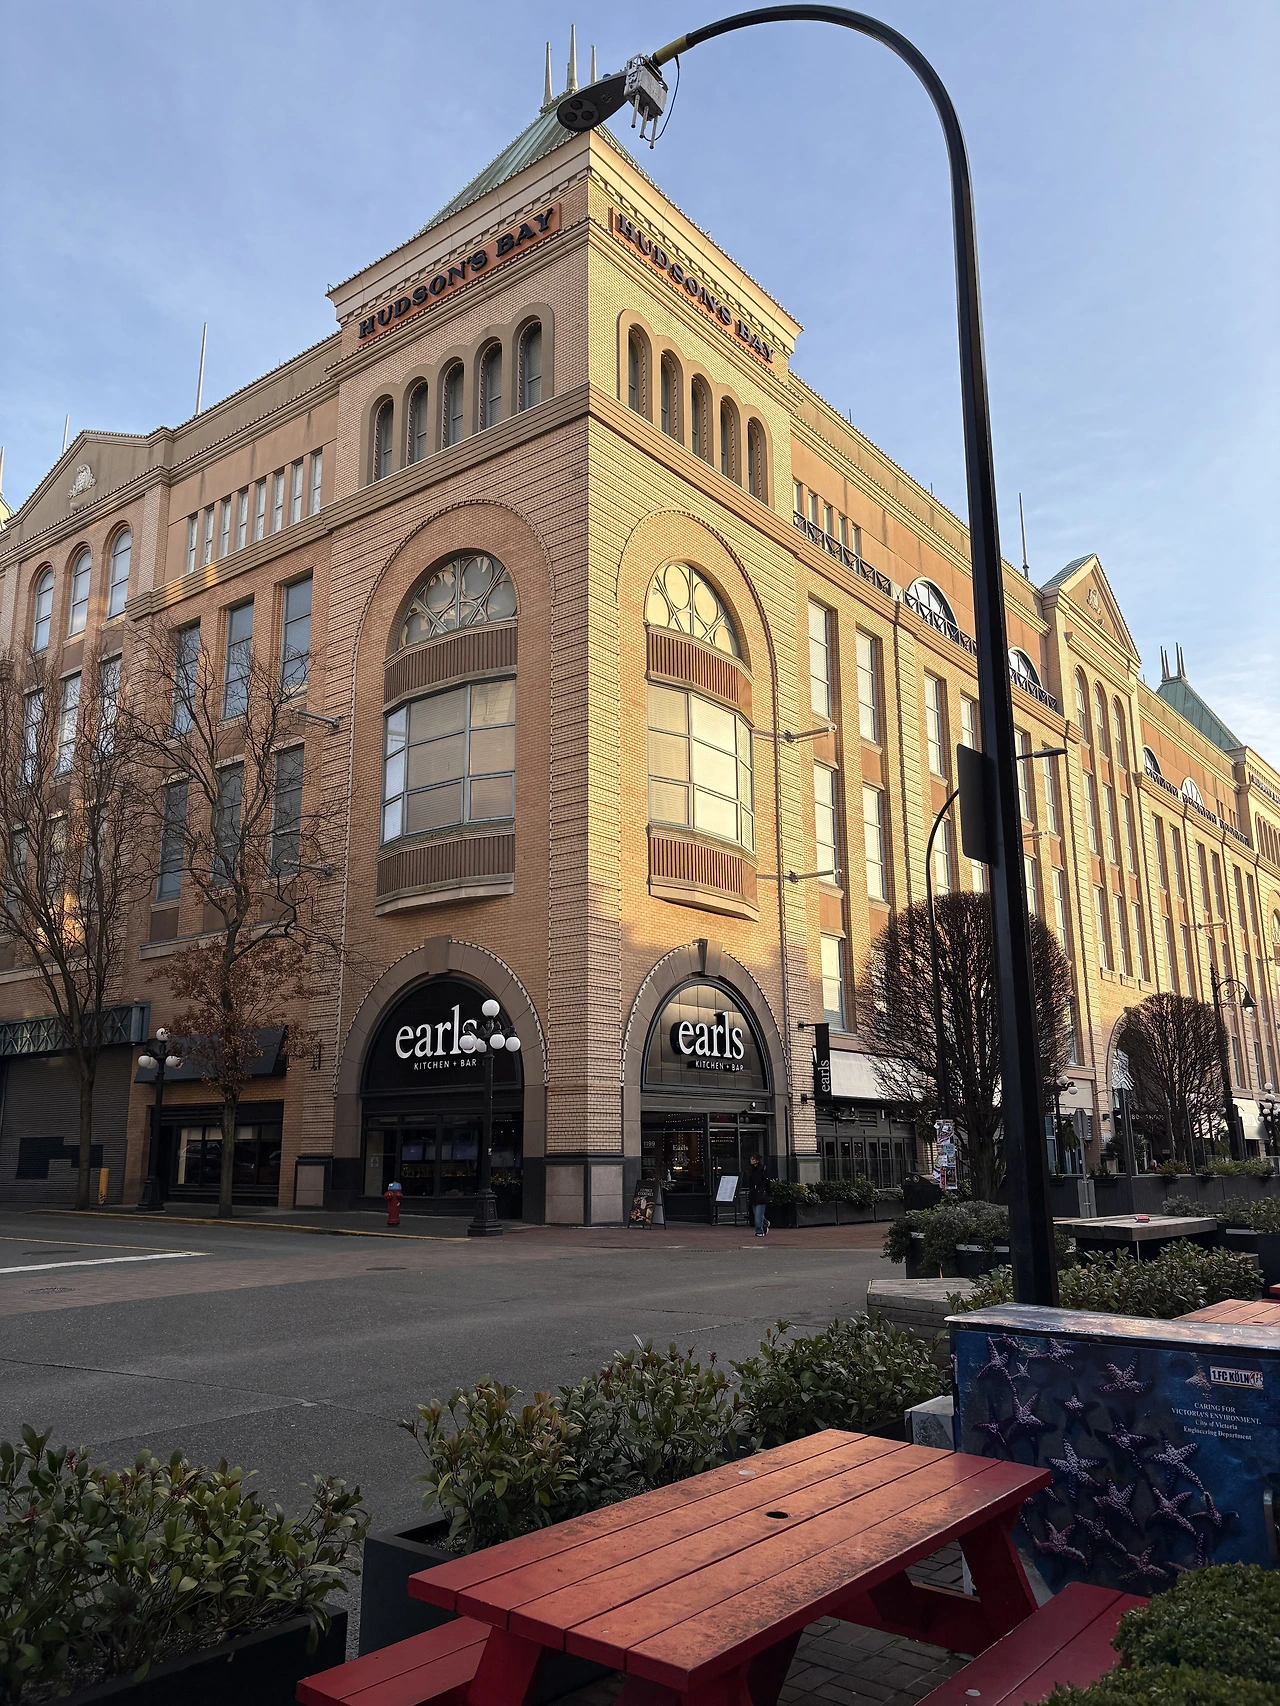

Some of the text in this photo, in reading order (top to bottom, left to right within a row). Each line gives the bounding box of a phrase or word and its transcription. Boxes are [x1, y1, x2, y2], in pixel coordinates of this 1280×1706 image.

[358, 207, 555, 339] HUDSON'S BAY
[617, 212, 775, 364] HUDSON'S BAY
[678, 1011, 745, 1060] earls
[413, 1060, 450, 1070] KITCHEN
[460, 1059, 477, 1067] BAR
[695, 1060, 724, 1070] KITCHEN
[731, 1063, 745, 1072] BAR
[817, 1059, 831, 1093] earls
[1211, 1369, 1228, 1382] 1.FC
[1228, 1370, 1250, 1384] KÖLN
[1171, 1407, 1209, 1418] VICTORIA'S
[1194, 1402, 1236, 1413] CARING FOR
[1195, 1419, 1208, 1428] City
[1214, 1421, 1238, 1430] Victoria
[1183, 1425, 1252, 1441] Engineering Department
